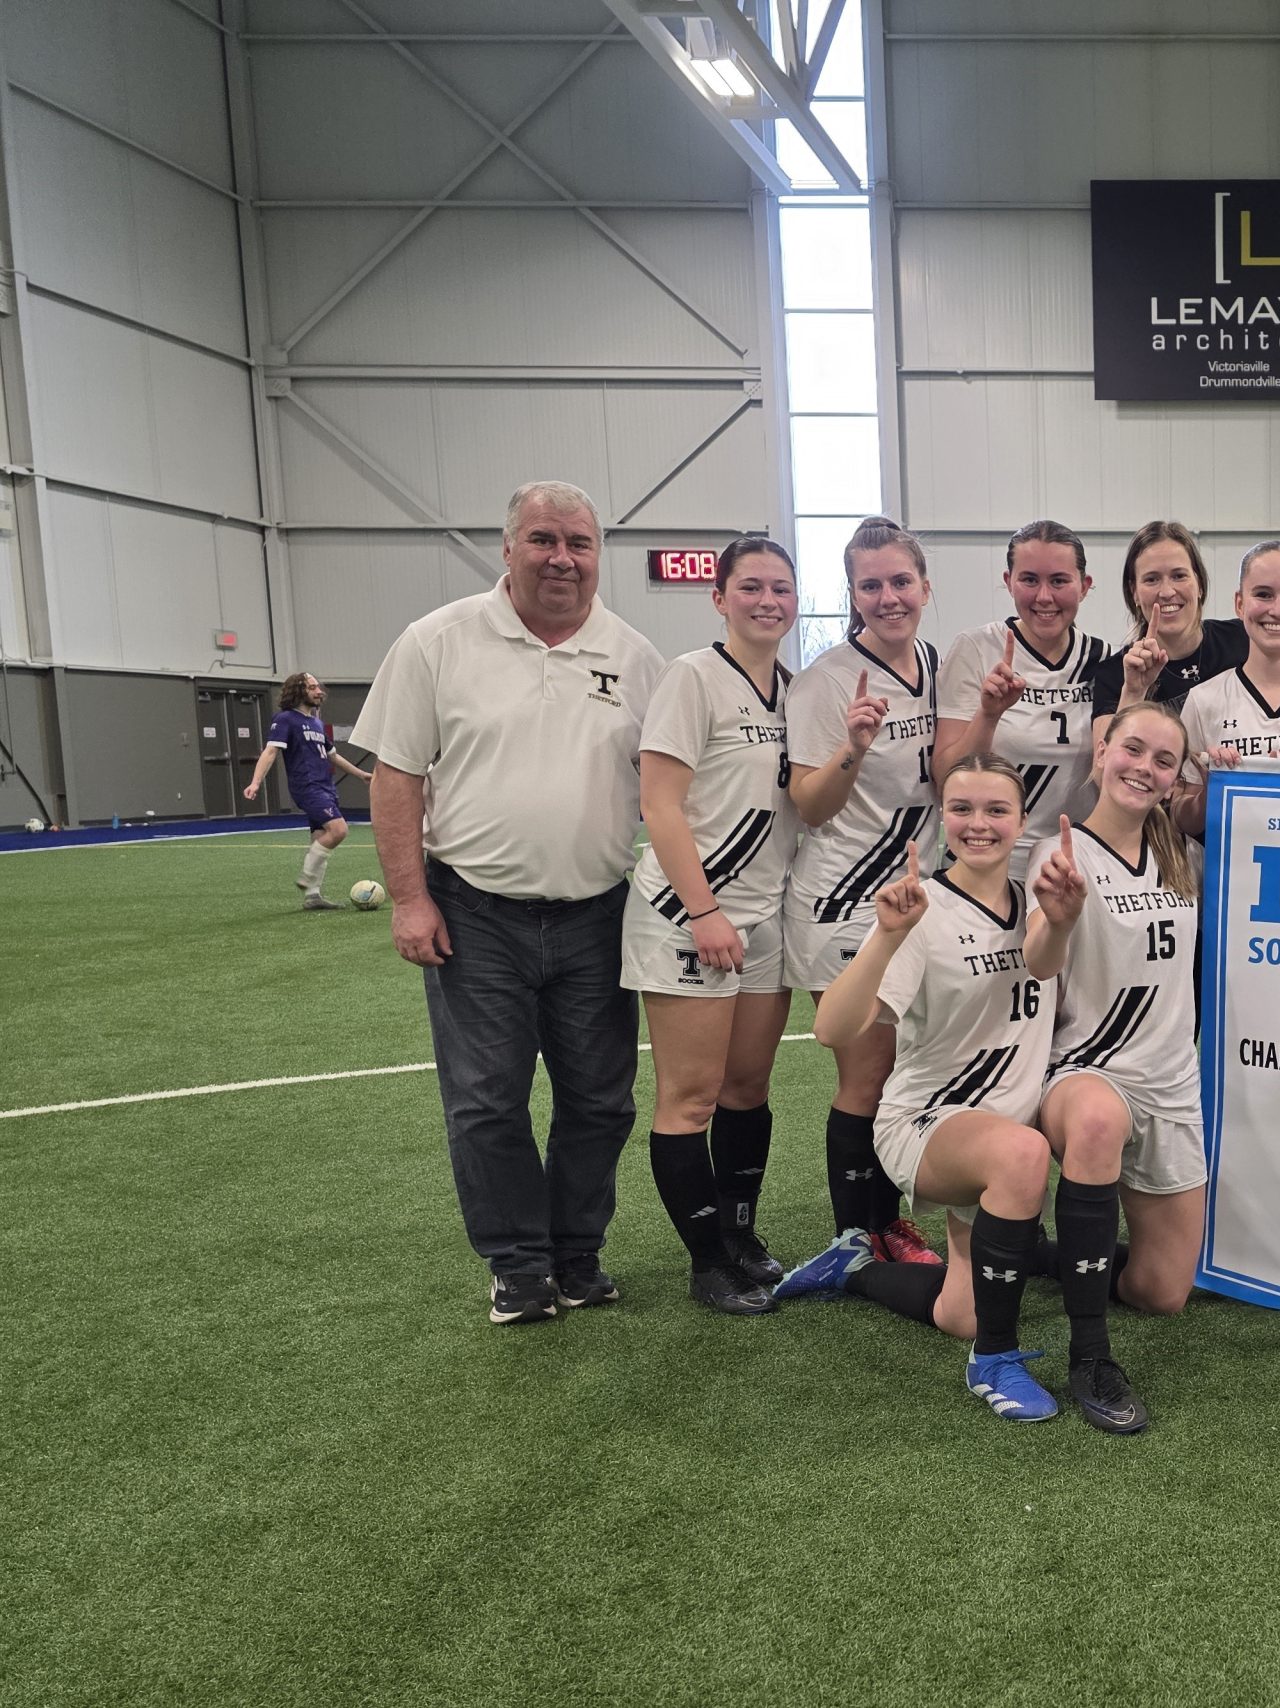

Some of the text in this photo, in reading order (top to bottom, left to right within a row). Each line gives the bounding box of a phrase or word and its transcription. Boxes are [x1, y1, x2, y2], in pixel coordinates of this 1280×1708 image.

[1207, 360, 1270, 373] Victoriaville
[661, 553, 716, 579] 16:08
[589, 669, 620, 696] T
[1021, 686, 1094, 705] HETFOR
[740, 725, 787, 744] THET
[1050, 710, 1070, 745] 7
[777, 752, 792, 789] 8
[1146, 919, 1176, 962] 15
[1009, 979, 1041, 1022] 16
